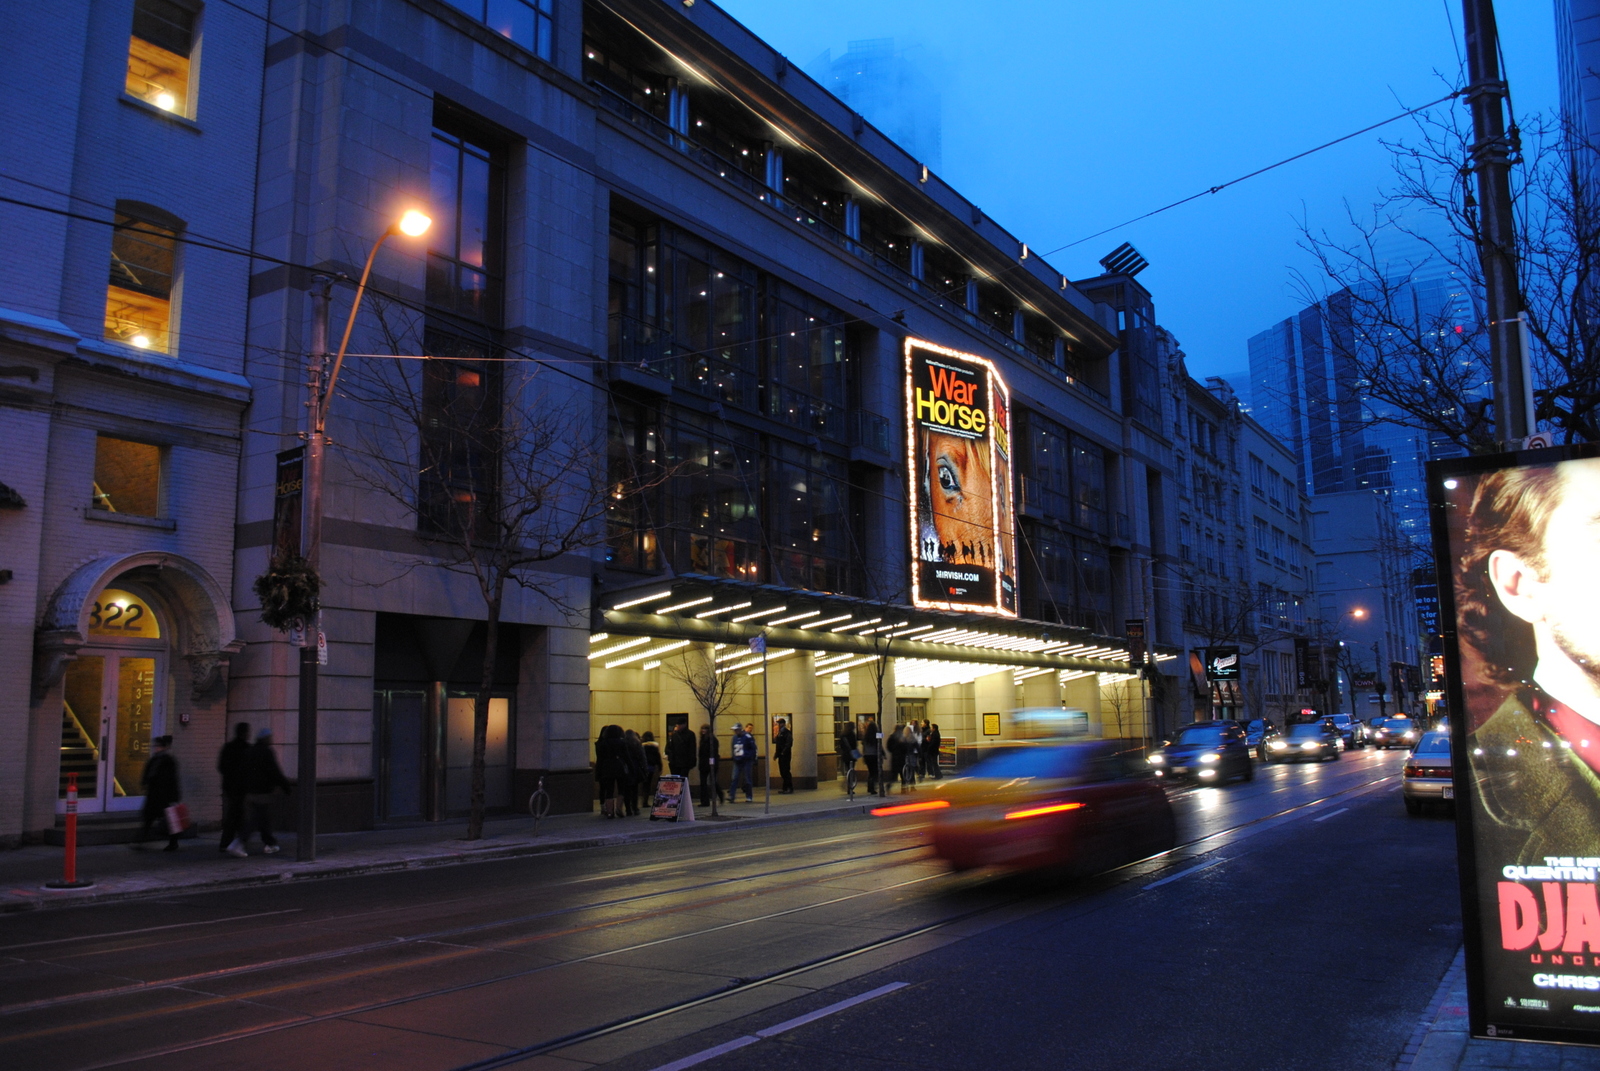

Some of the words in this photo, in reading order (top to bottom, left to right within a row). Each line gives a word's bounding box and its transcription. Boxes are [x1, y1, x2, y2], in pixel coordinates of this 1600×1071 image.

[928, 365, 977, 405] War
[916, 387, 986, 432] Horse
[276, 478, 303, 495] Horse
[138, 672, 143, 682] 4
[136, 688, 142, 699] 3
[136, 704, 141, 715] 2
[1544, 856, 1575, 867] THE
[1502, 866, 1595, 881] QUENTIN
[1533, 973, 1600, 990] CHRIS
